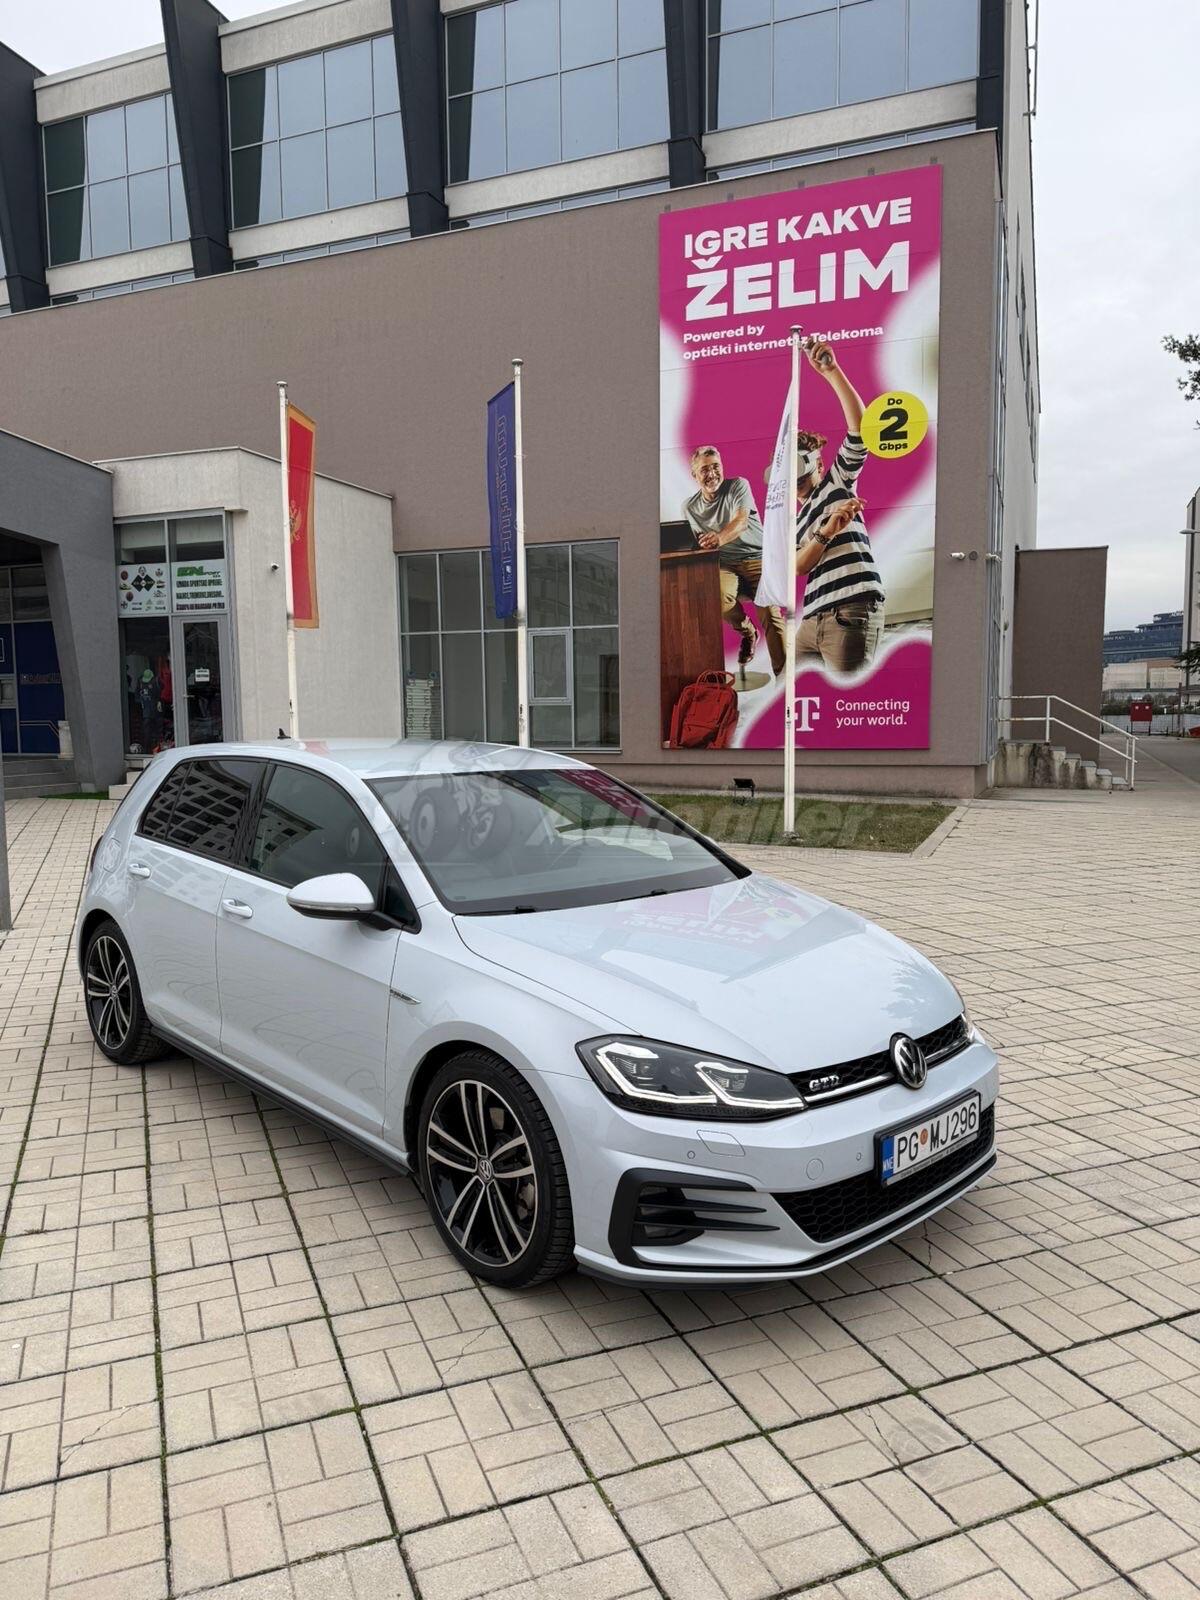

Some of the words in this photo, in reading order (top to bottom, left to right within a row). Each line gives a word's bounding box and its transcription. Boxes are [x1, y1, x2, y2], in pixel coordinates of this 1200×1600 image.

[684, 220, 768, 258] IGRE
[777, 196, 912, 243] KAKVE
[685, 240, 910, 322] ŽELIM
[682, 343, 732, 361] optički
[734, 337, 794, 353] internet
[809, 325, 884, 344] Telekoma
[683, 325, 744, 344] Powered
[747, 324, 765, 337] by
[887, 397, 903, 406] Do
[879, 408, 909, 441] 2
[878, 441, 908, 453] Gbps
[794, 696, 820, 732] T
[835, 698, 910, 712] Connecting
[836, 716, 865, 729] your
[867, 713, 907, 726] world.
[809, 1074, 840, 1092] GTD
[897, 1131, 919, 1168] PG
[929, 1101, 977, 1152] MJ296
